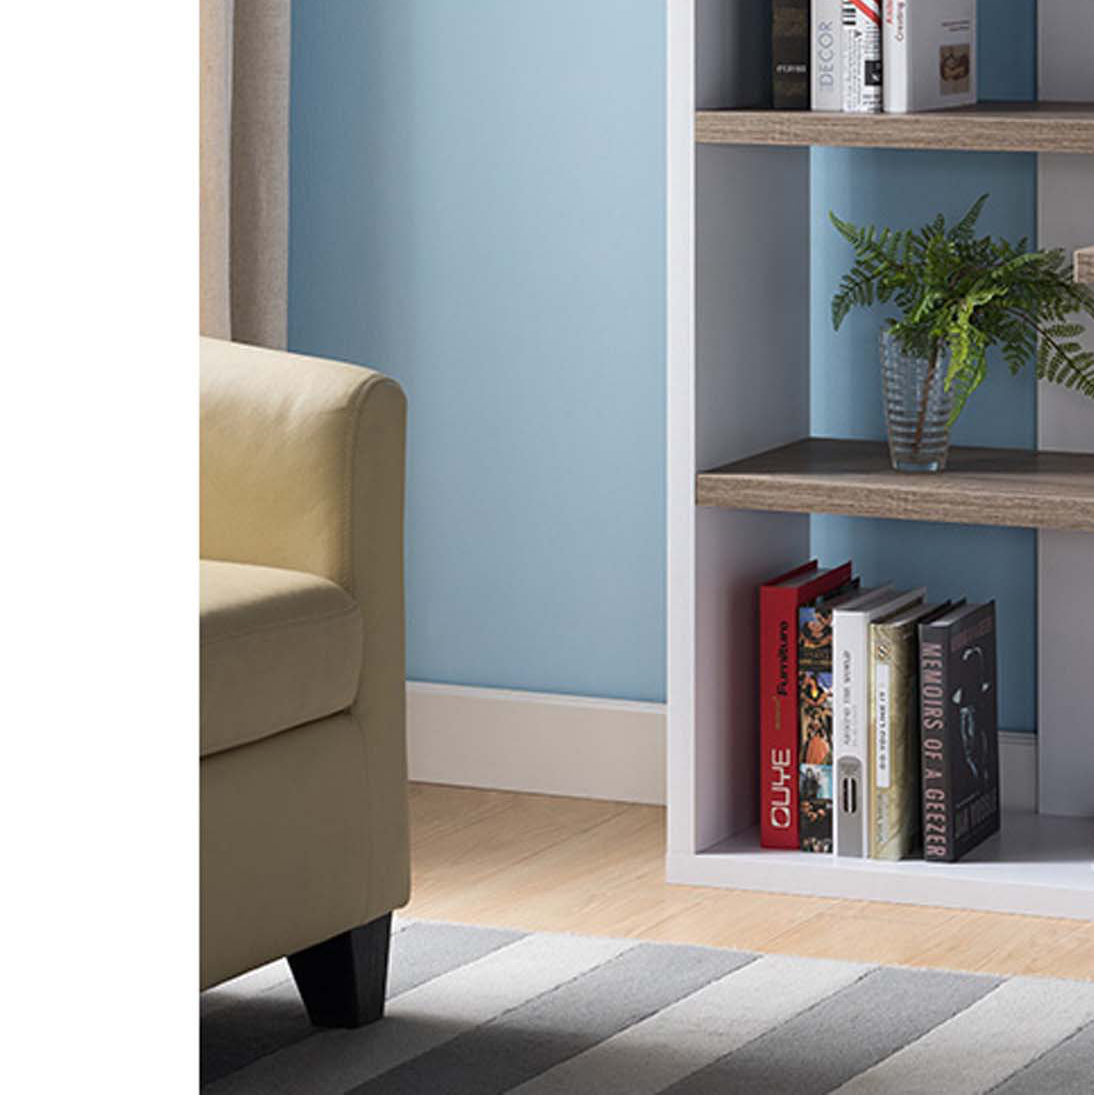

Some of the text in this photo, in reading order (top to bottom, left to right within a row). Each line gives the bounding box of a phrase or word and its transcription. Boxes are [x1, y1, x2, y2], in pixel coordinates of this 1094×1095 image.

[818, 21, 834, 88] DECOR
[776, 620, 789, 696] Furniture
[922, 643, 943, 731] MEMOIRS
[771, 748, 791, 828] OUYE
[923, 738, 944, 765] OF
[923, 788, 945, 858] GEEZER
